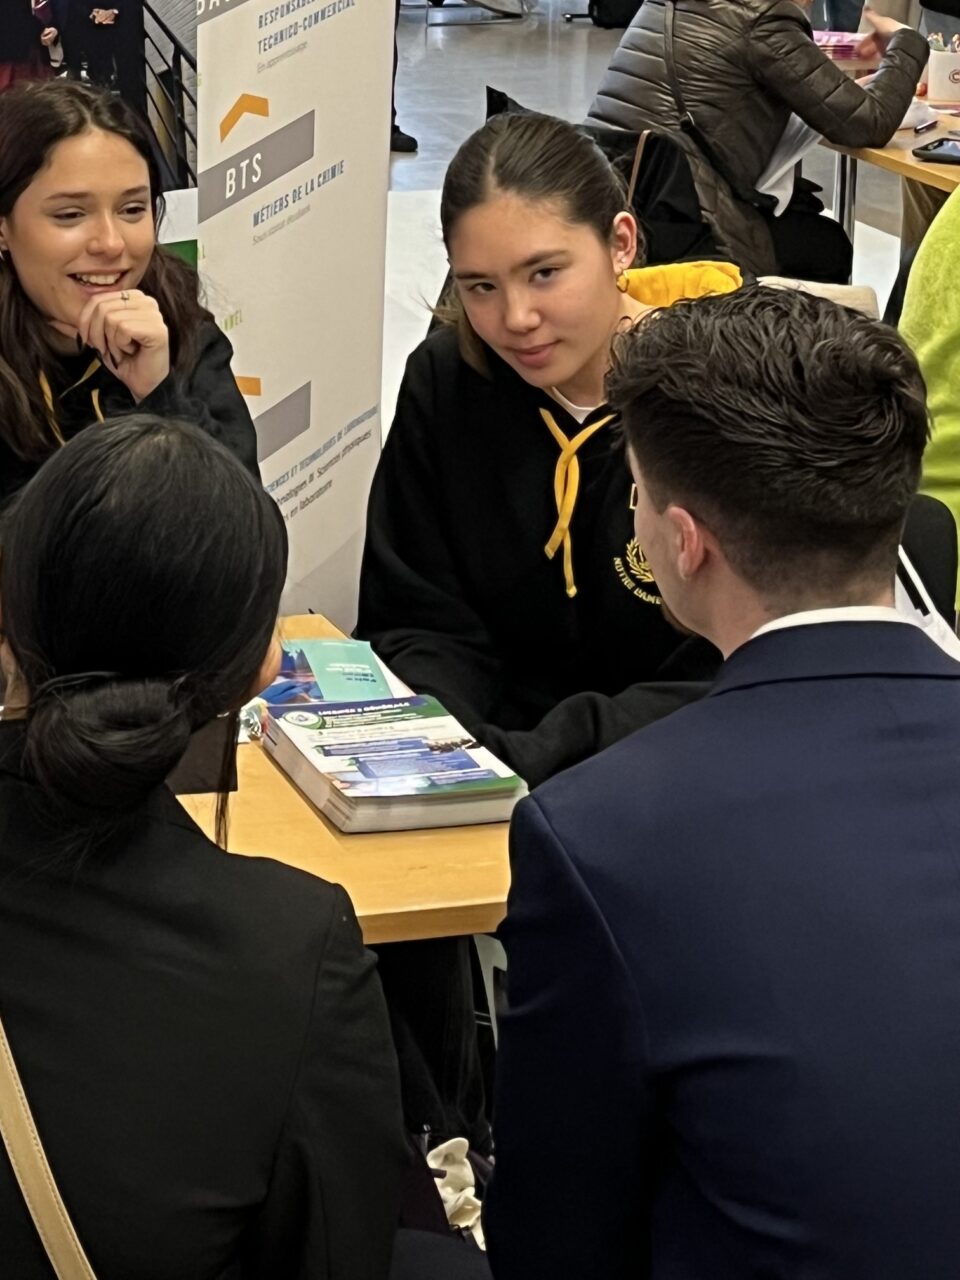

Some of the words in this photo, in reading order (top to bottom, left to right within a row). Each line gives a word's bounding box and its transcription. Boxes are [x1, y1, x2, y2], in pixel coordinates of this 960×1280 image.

[226, 153, 261, 199] BTS
[253, 194, 289, 227] MÉTIERS
[293, 185, 302, 204] DE
[305, 177, 314, 195] LA
